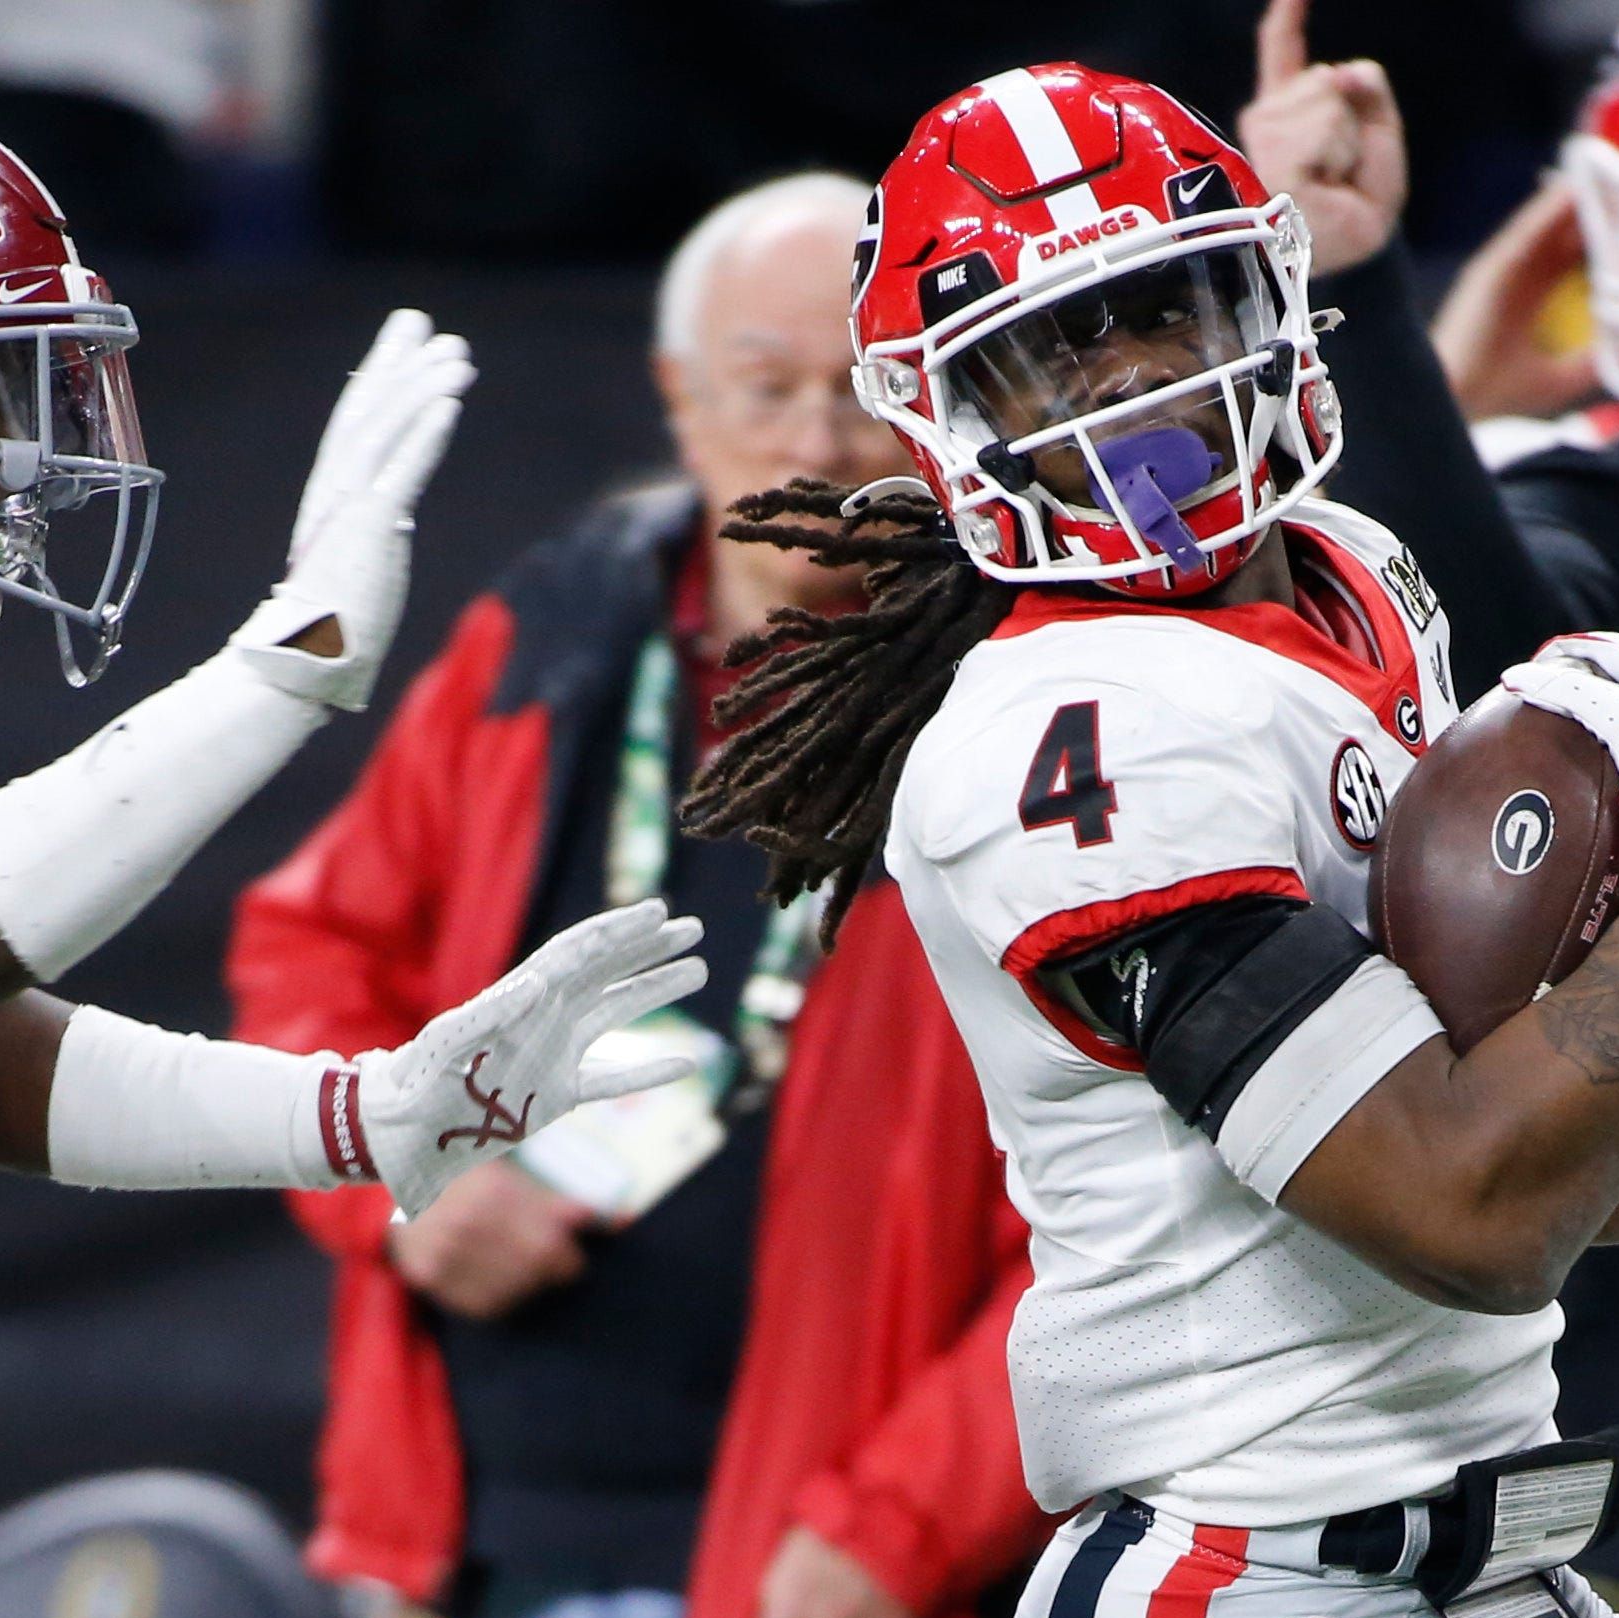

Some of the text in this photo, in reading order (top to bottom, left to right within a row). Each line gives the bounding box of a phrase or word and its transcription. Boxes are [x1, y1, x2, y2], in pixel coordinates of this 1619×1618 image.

[1036, 210, 1139, 262] DAWGS
[937, 263, 968, 294] NIKE
[1396, 695, 1423, 744] G
[1017, 699, 1119, 850] 4
[1334, 745, 1387, 842] SEC
[1493, 790, 1554, 874] G
